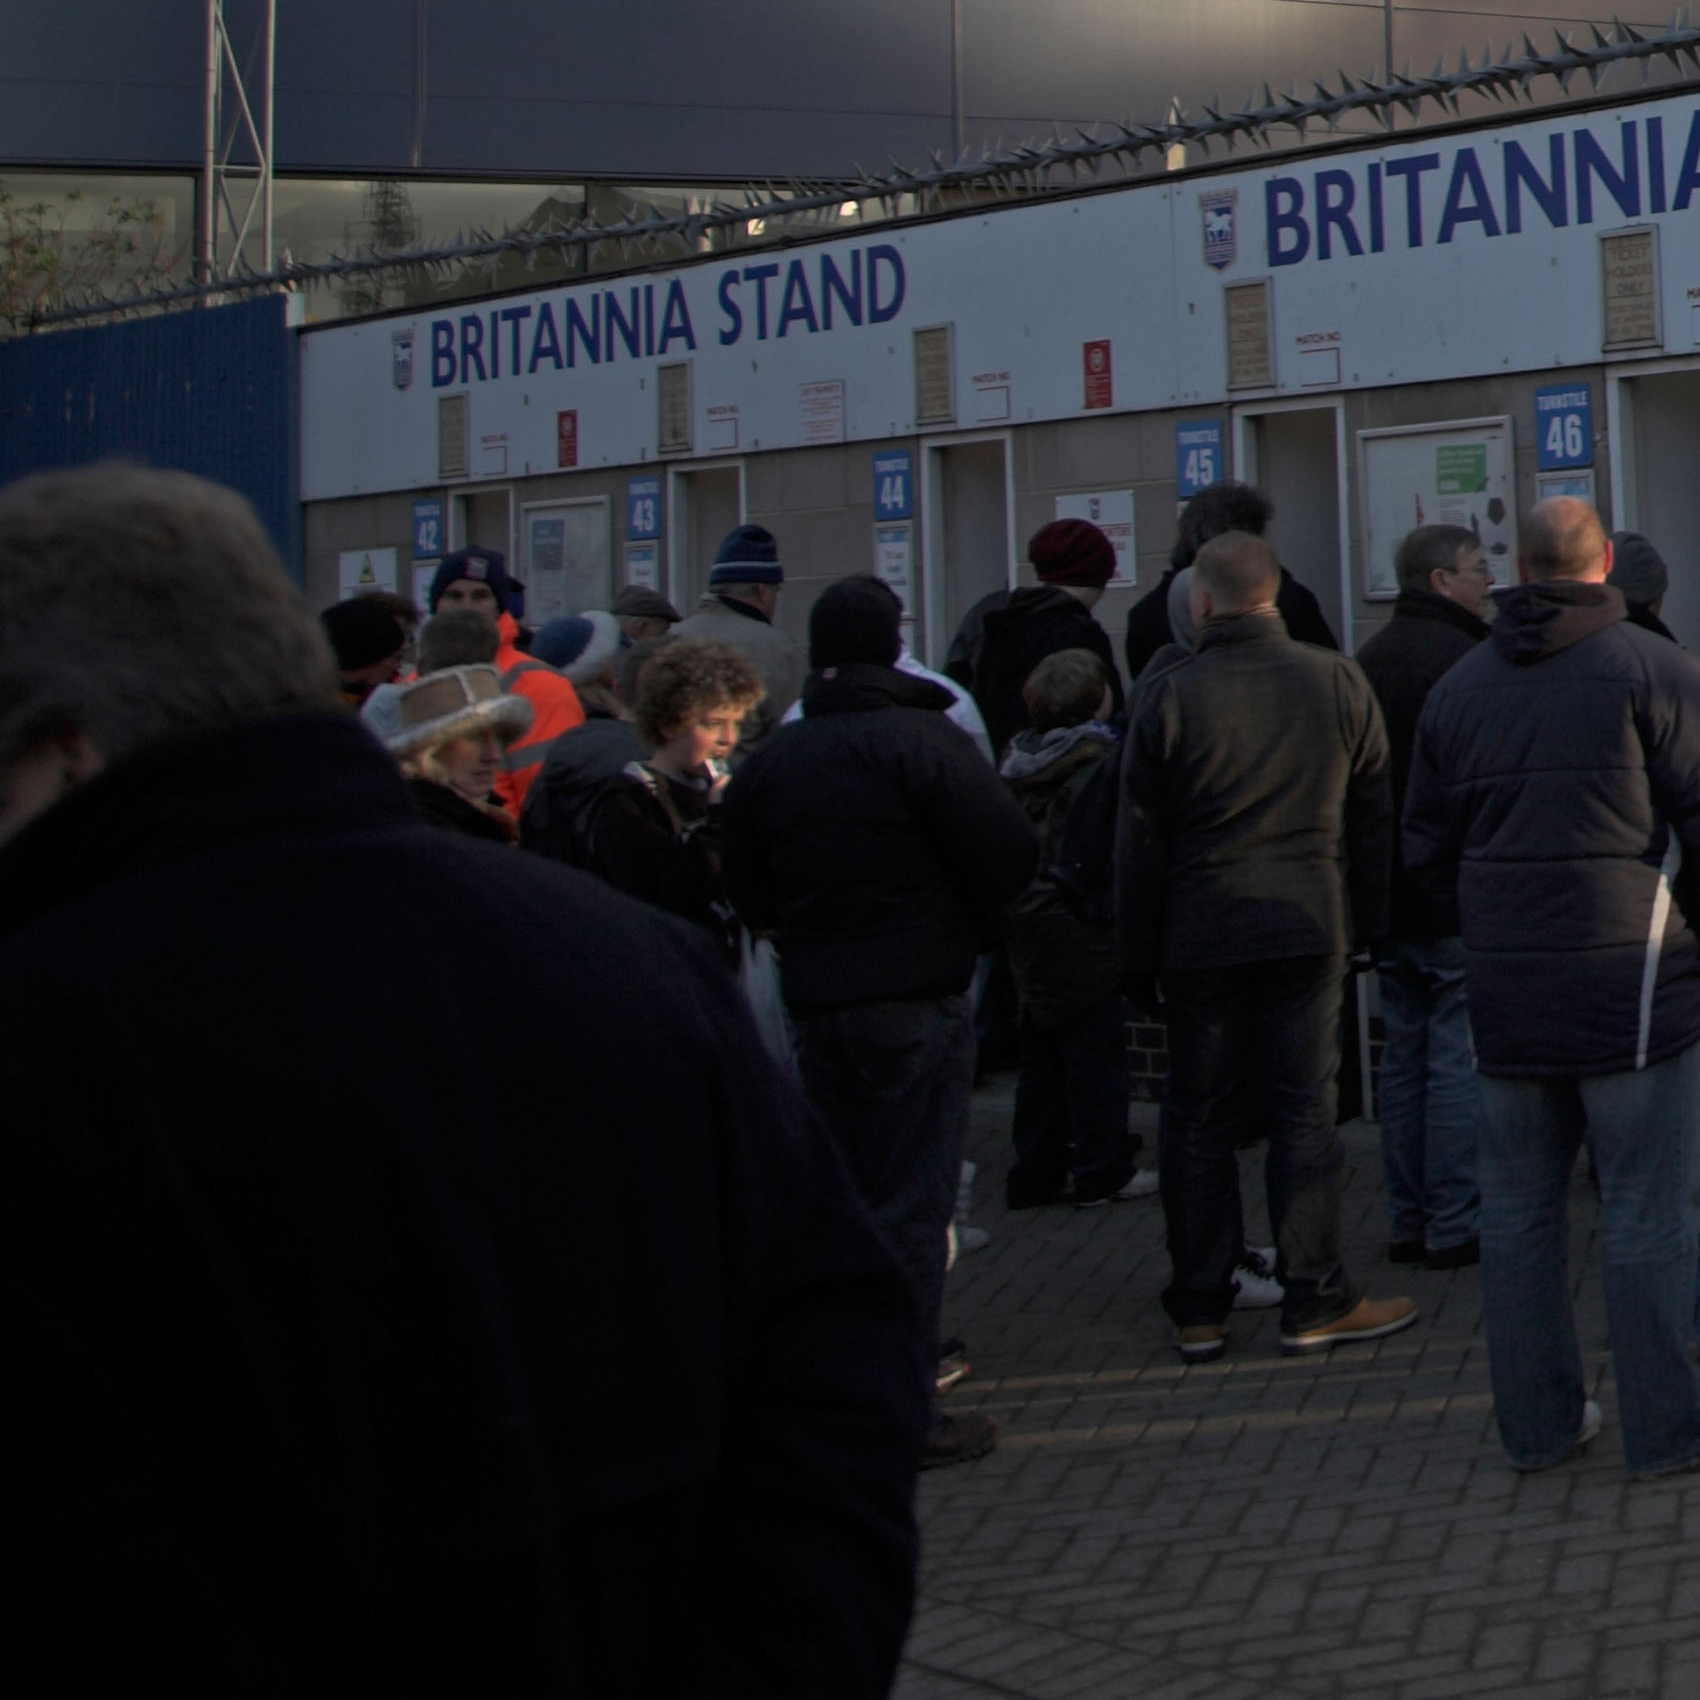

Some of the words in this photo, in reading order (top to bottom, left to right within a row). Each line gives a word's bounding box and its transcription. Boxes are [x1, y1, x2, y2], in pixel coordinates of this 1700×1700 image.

[431, 280, 696, 387] BRITANNIA
[717, 244, 905, 345] STAND
[1537, 390, 1588, 411] TURNSTILE
[1545, 413, 1583, 460] 46
[1185, 448, 1213, 486] 45
[880, 475, 905, 510] 44
[632, 498, 654, 532] 43
[418, 519, 438, 552] 42
